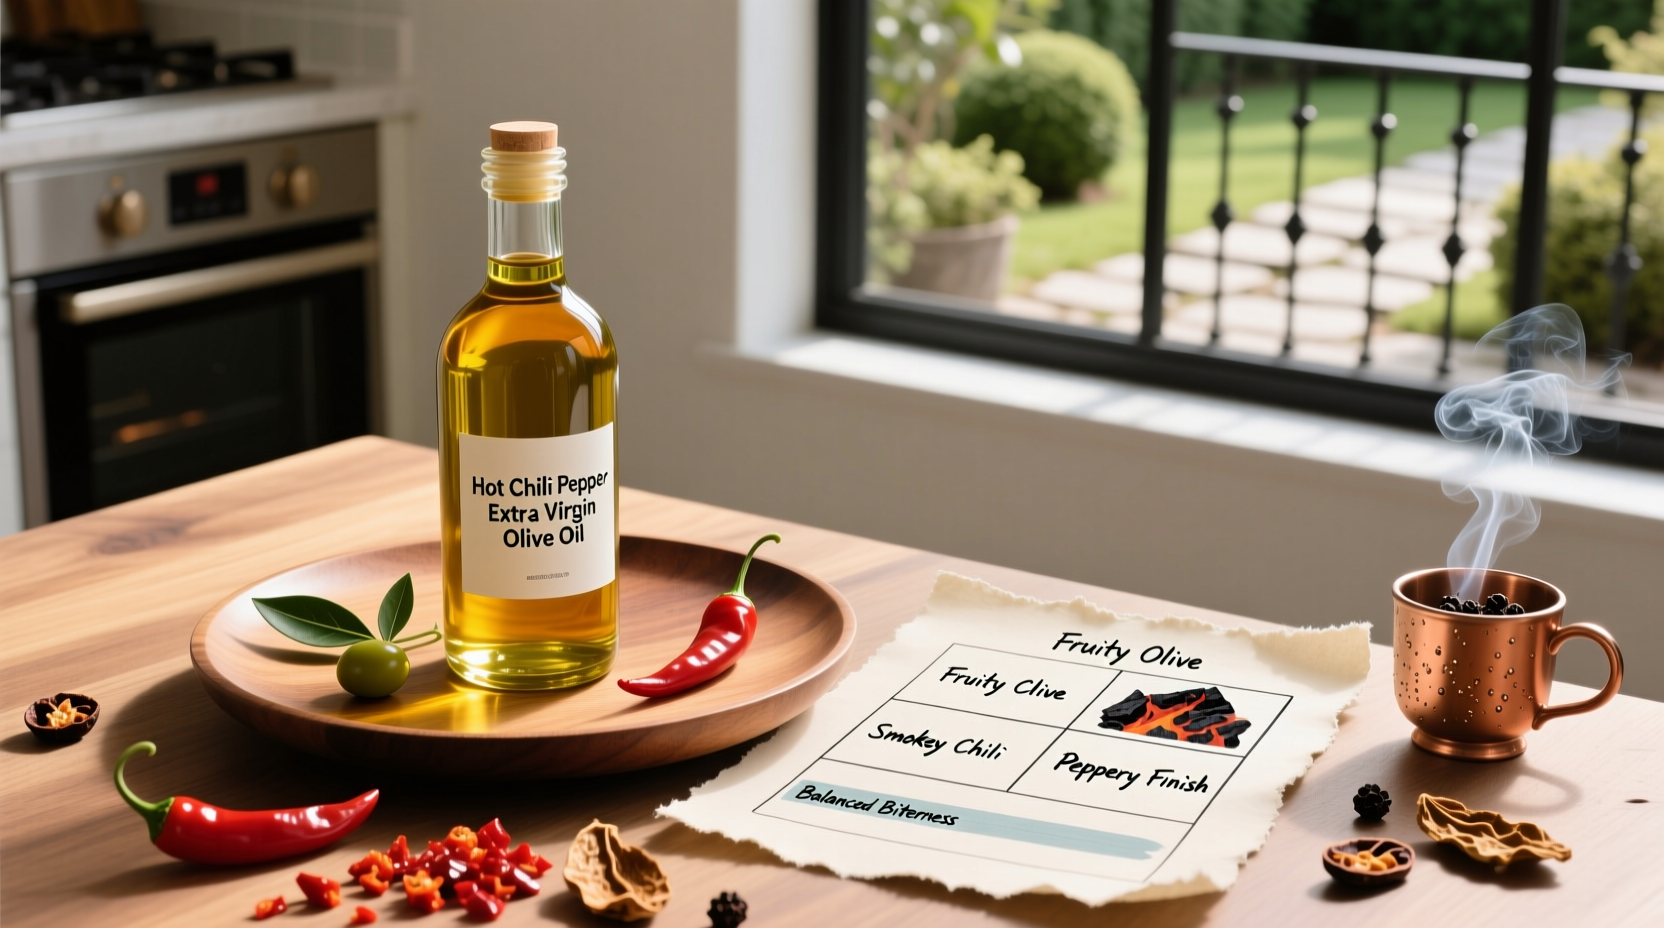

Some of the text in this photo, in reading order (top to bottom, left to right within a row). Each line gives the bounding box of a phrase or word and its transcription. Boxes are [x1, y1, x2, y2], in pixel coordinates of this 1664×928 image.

[472, 472, 609, 497] Hot Chili Pepper
[488, 498, 596, 524] Extra Virgin
[503, 523, 585, 548] Olive Oil
[1052, 632, 1203, 670] Fruity Olive
[940, 667, 1006, 696] Fruity
[868, 723, 1007, 760] Smokey Chili
[1053, 752, 1209, 794] Peppery Finish
[795, 785, 879, 811] Balanced
